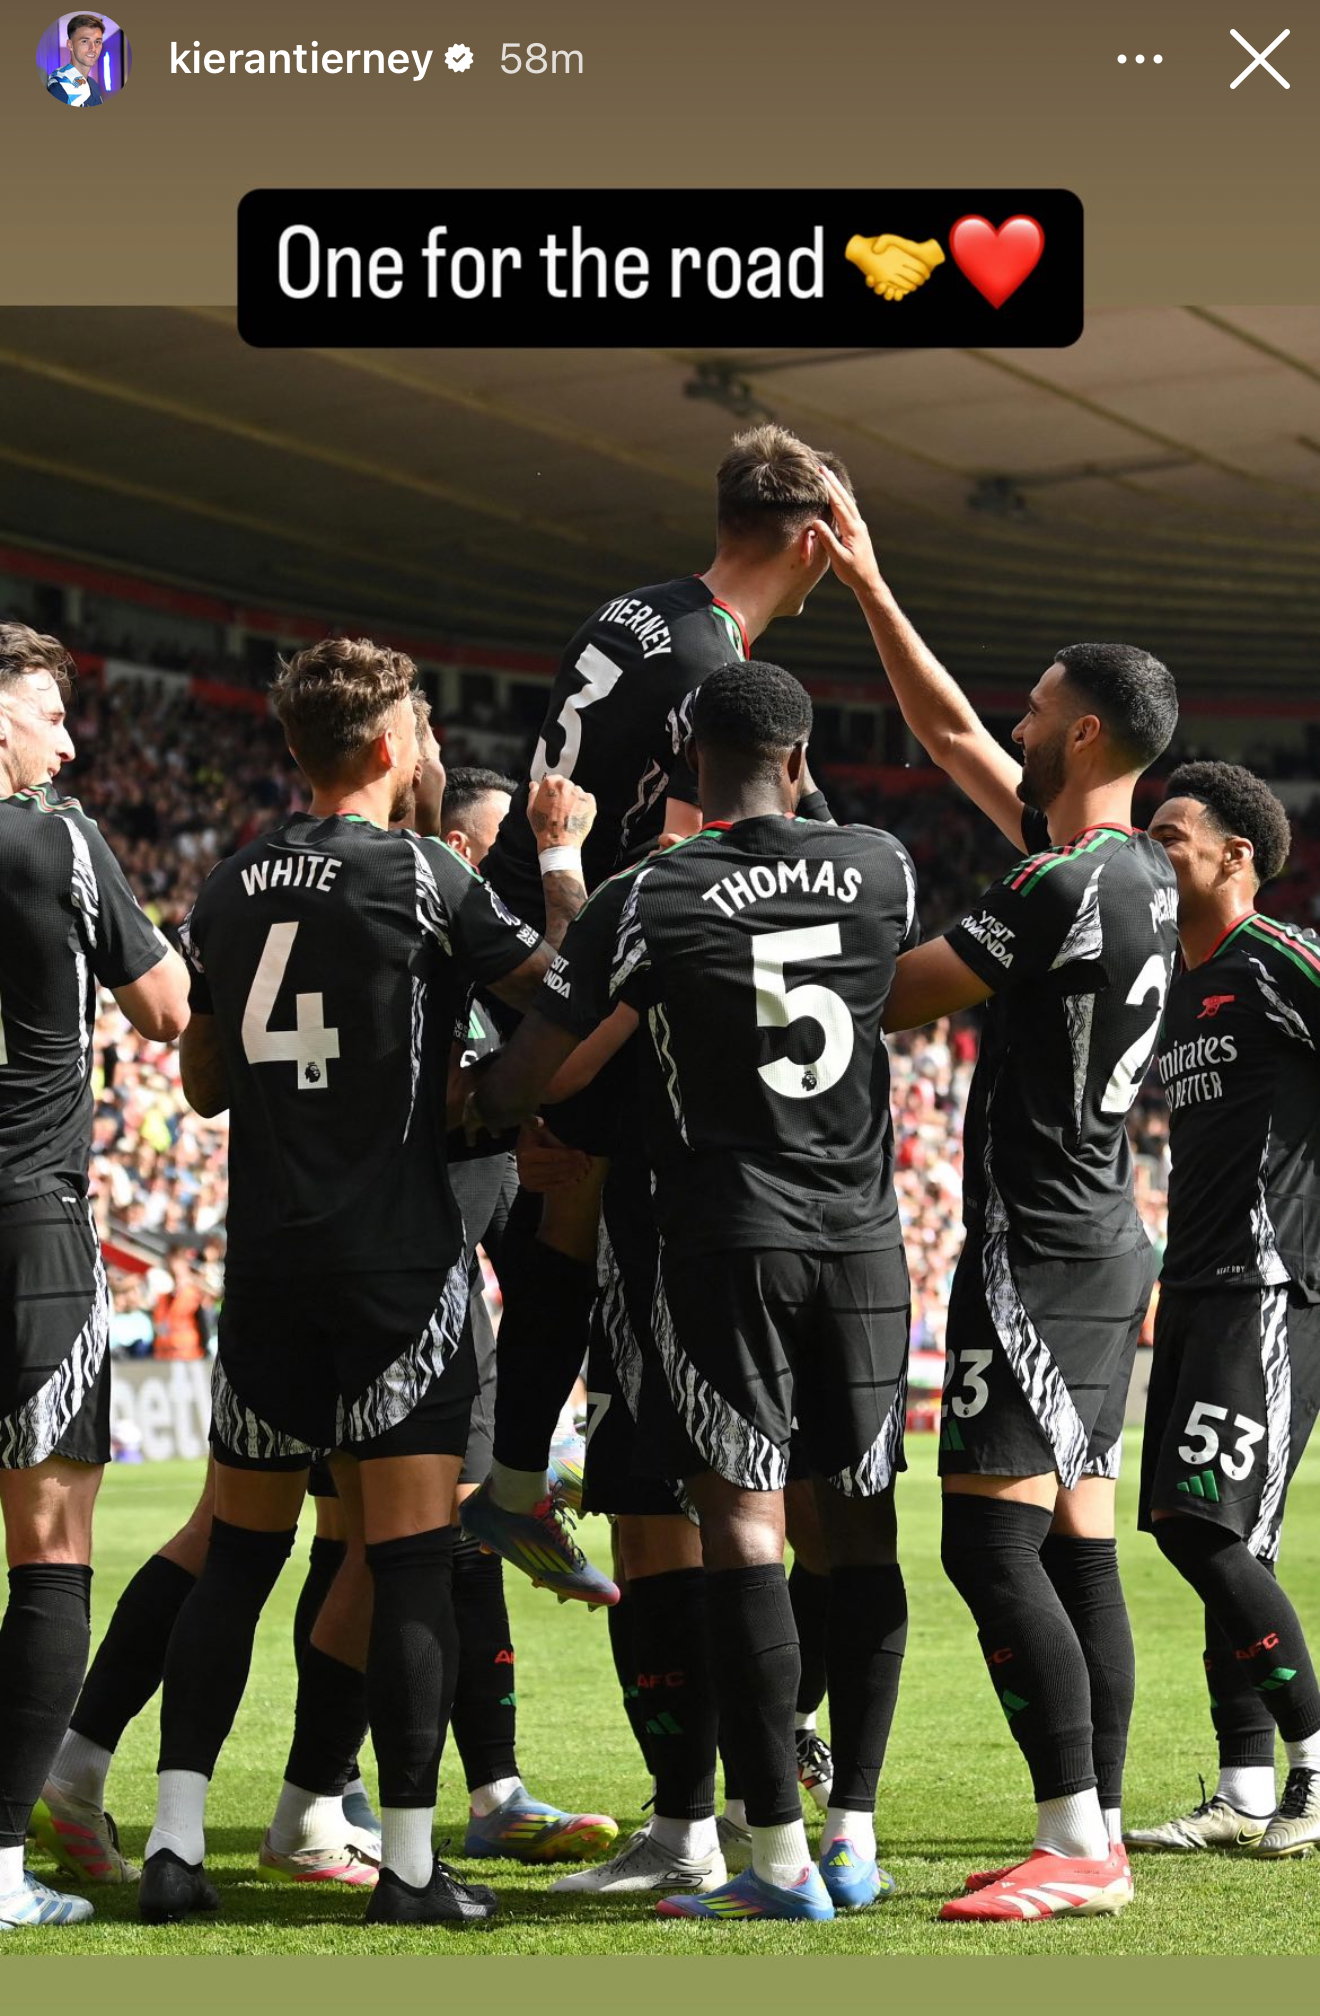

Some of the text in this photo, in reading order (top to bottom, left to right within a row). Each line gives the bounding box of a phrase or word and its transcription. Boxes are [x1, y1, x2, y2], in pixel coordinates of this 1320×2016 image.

[599, 598, 672, 660] TIERNEY
[530, 643, 624, 783] 3
[241, 853, 343, 897] WHITE
[702, 858, 863, 918] THOMAS
[979, 910, 1016, 942] VISIT
[543, 969, 571, 999] NDA
[550, 954, 570, 974] SIT
[242, 921, 341, 1090] 4
[752, 923, 855, 1098] 5
[1158, 1033, 1238, 1084] mirates
[1175, 1071, 1223, 1110] BETTER
[1178, 1400, 1267, 1481] 53
